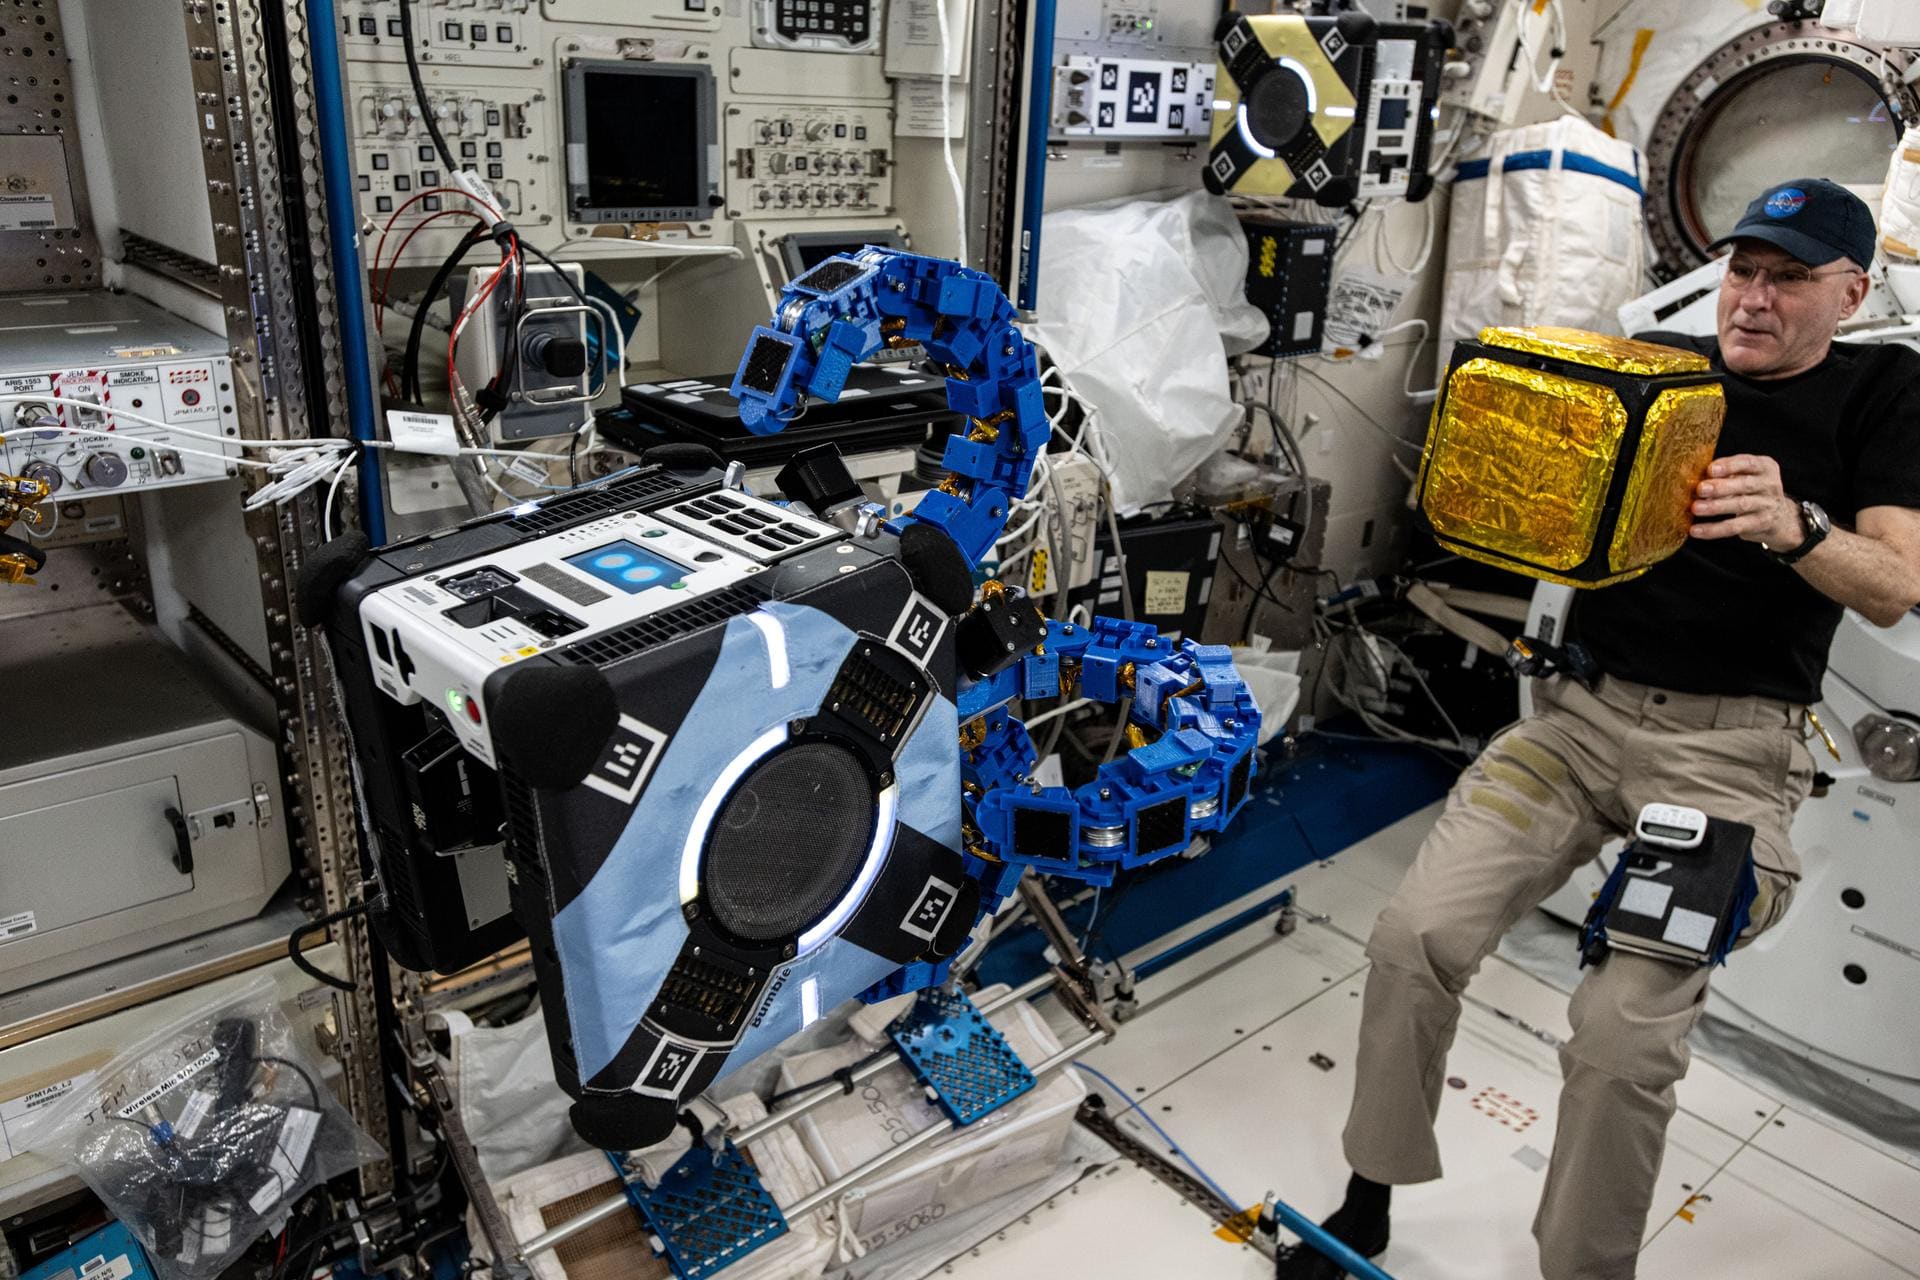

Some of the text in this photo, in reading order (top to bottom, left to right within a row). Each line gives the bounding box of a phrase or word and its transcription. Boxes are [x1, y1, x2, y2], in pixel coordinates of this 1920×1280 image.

[78, 385, 91, 393] ON
[81, 422, 98, 430] OFF
[122, 1088, 162, 1116] Wireless
[161, 1079, 178, 1092] Mic
